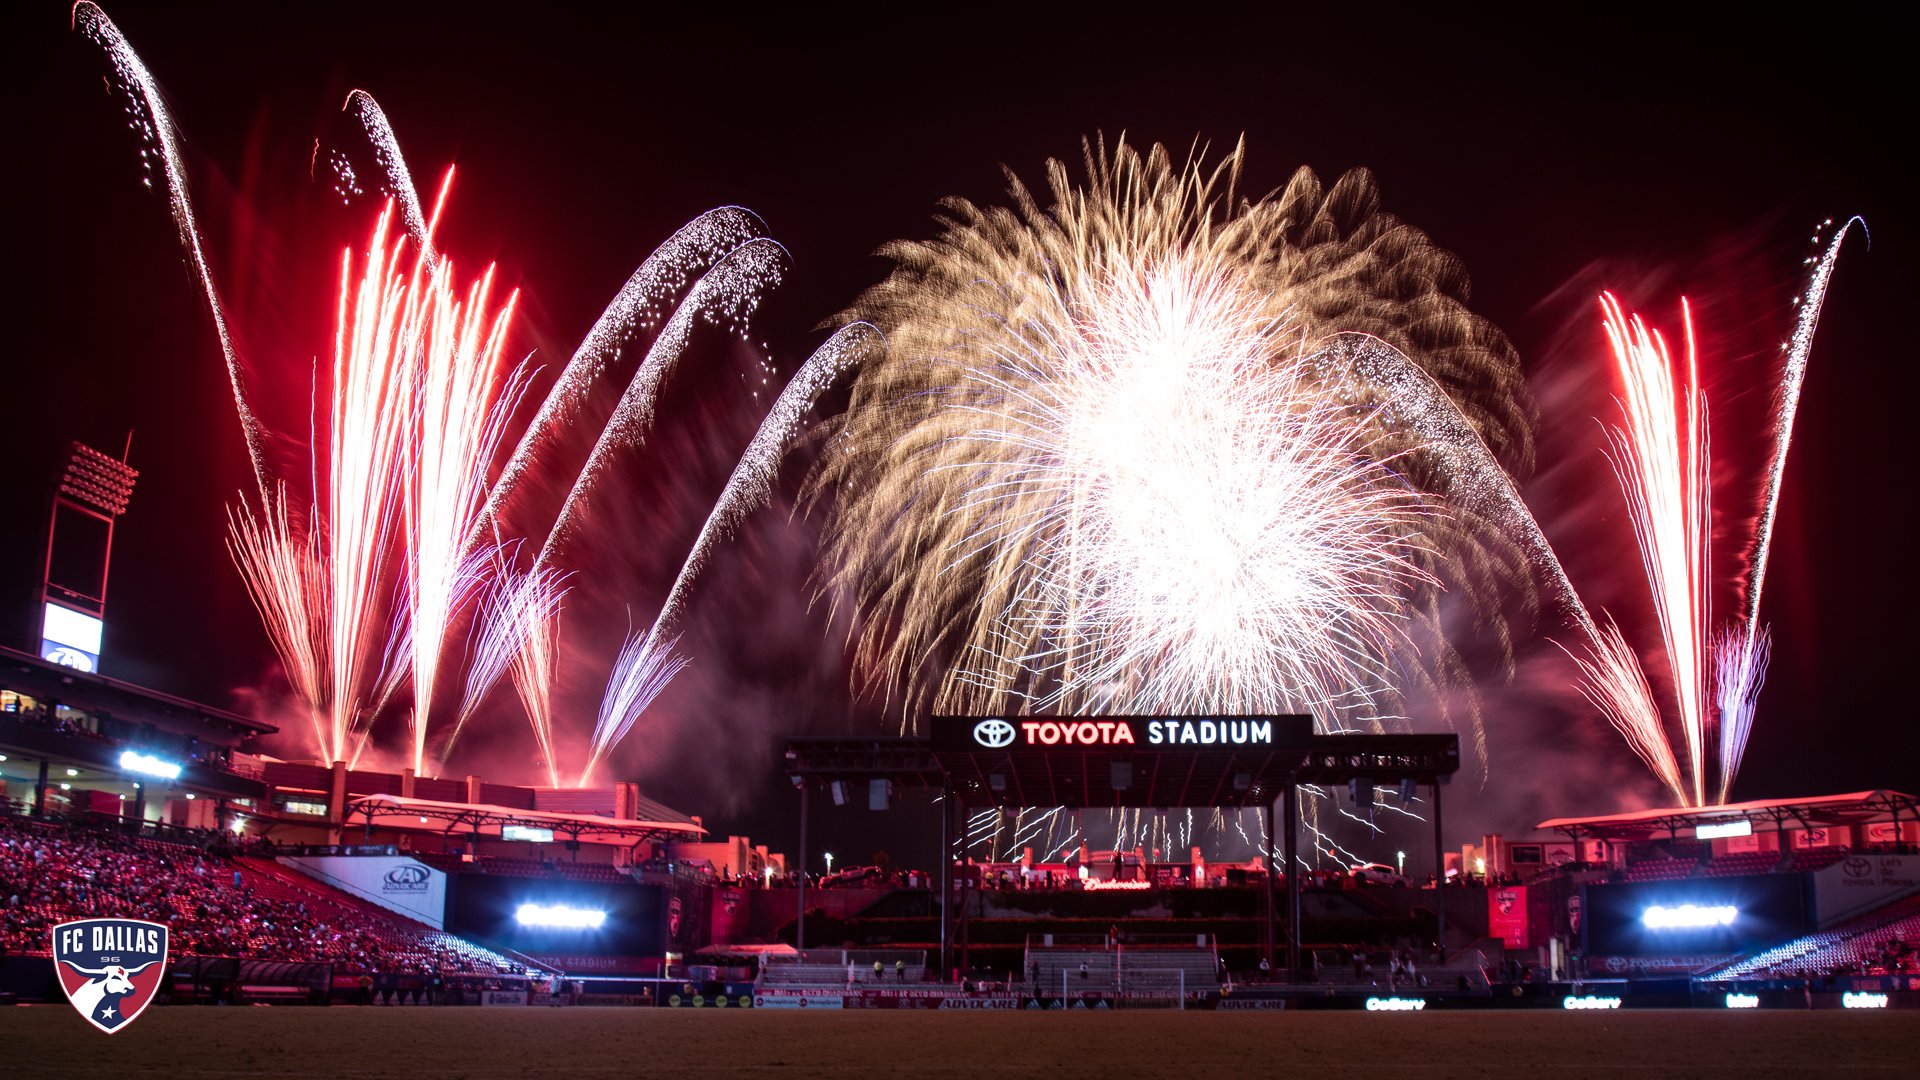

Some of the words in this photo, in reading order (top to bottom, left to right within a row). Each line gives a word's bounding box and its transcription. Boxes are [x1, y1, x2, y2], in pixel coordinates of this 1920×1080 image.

[1022, 722, 1135, 744] TOYOTA
[1148, 721, 1272, 744] STADIUM
[1081, 877, 1151, 890] Budweiser
[566, 957, 617, 968] STADIUM
[1630, 958, 1676, 968] TOYOTA
[944, 999, 1017, 1009] ADVOCARE
[1219, 999, 1285, 1009] ADVOCARE
